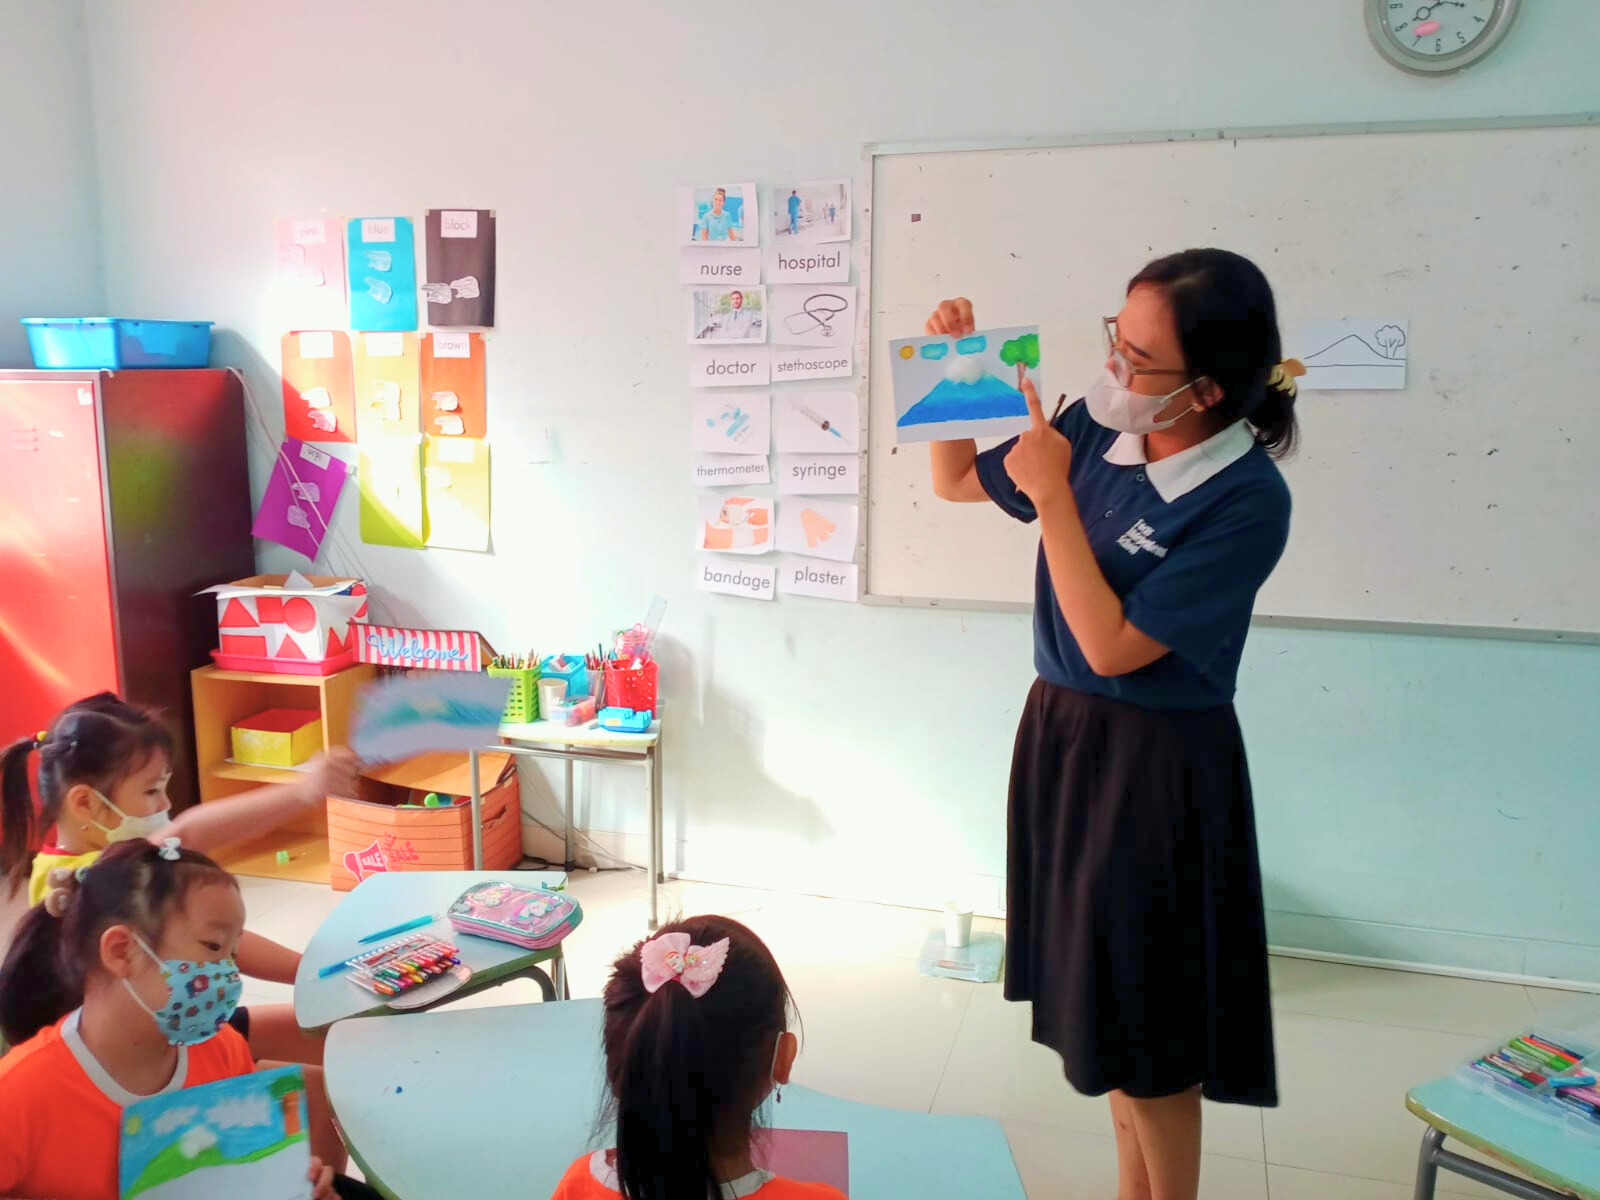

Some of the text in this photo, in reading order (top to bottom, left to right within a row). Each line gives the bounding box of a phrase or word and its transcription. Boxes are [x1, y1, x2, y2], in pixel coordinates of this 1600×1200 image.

[1435, 38, 1442, 52] 6
[1456, 31, 1466, 44] 5
[778, 251, 841, 272] hospital
[700, 263, 743, 276] nurse
[706, 360, 757, 375] doctor
[776, 357, 848, 372] stethoscope
[696, 464, 765, 477] thermometer
[792, 463, 847, 480] syringe
[703, 566, 770, 591] bandage
[794, 566, 846, 585] plaster
[367, 632, 469, 662] Welcome
[361, 852, 385, 868] SALE
